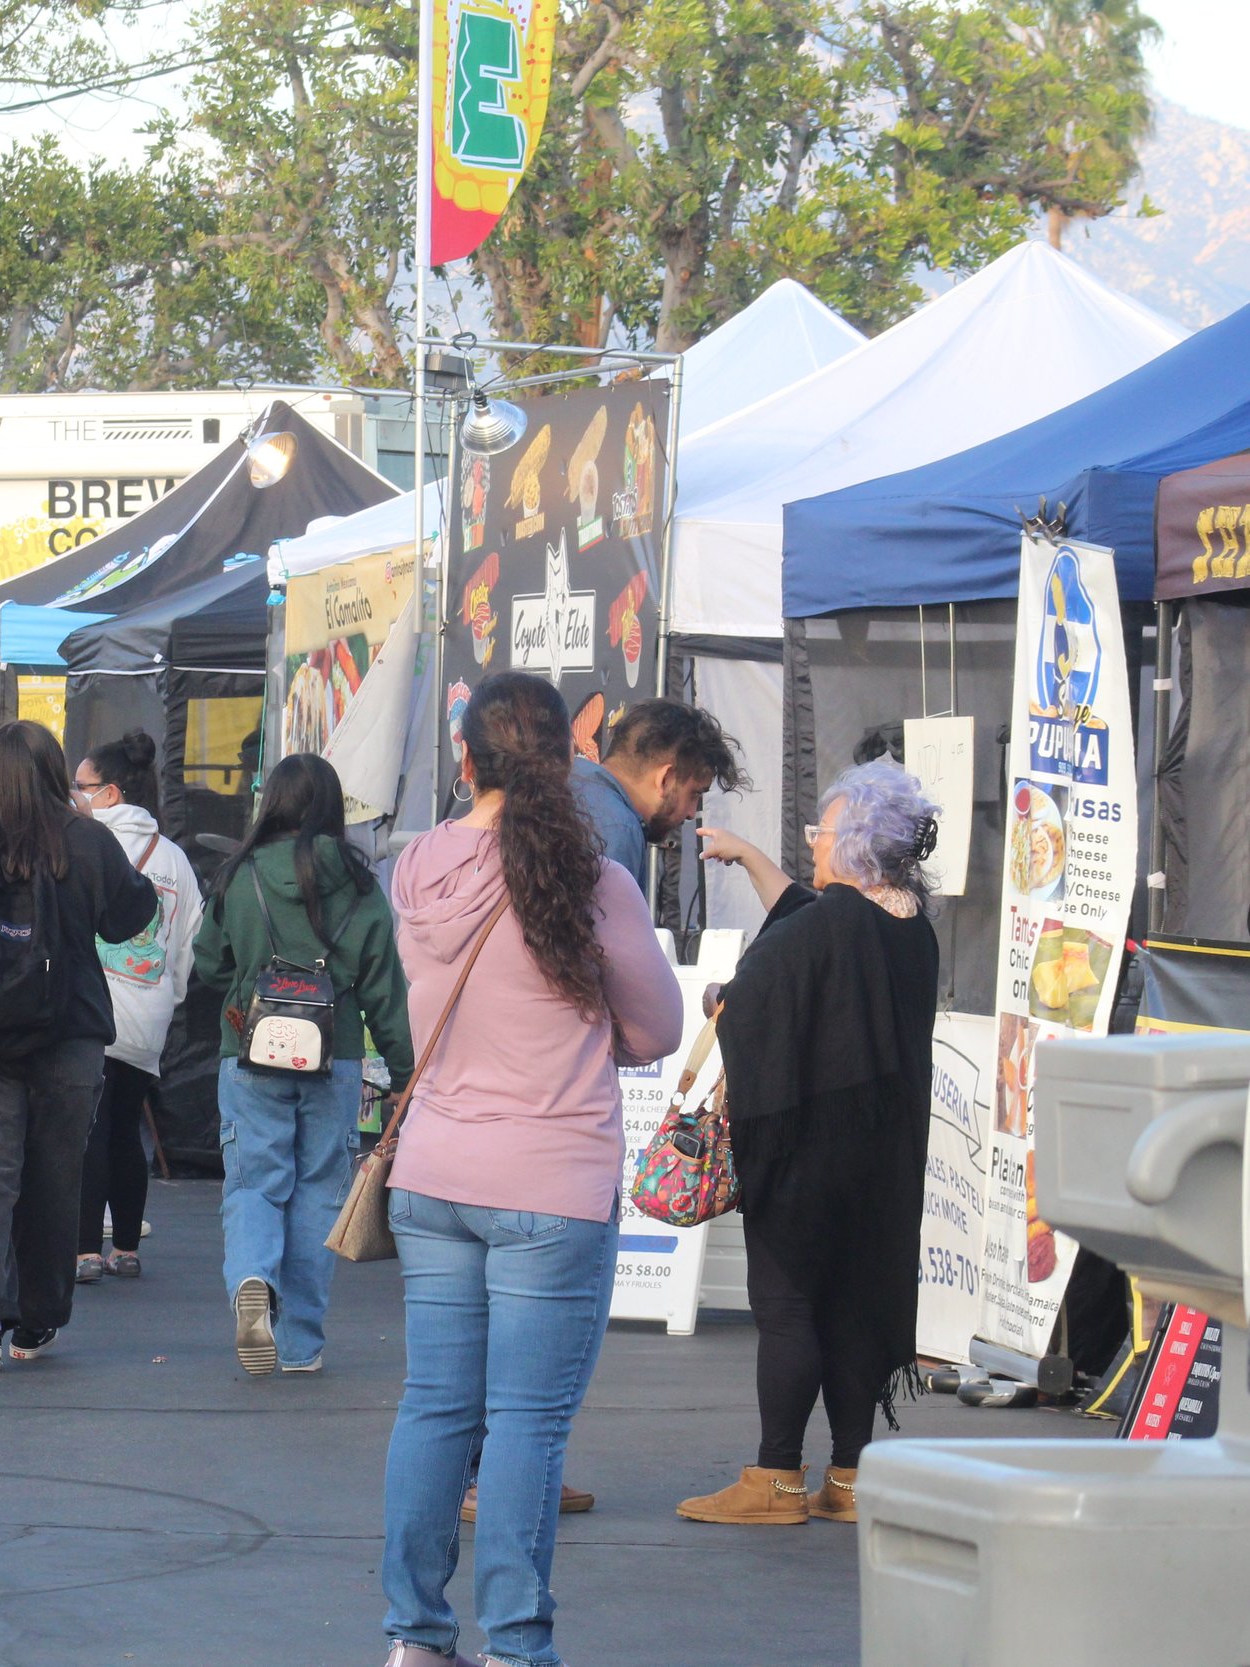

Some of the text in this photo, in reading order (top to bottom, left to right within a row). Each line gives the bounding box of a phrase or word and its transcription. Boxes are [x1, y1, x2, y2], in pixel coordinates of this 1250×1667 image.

[48, 420, 97, 441] THE
[325, 586, 372, 629] El Comalito
[514, 607, 590, 666] Coyote Elote
[152, 872, 177, 888] Today
[628, 1088, 664, 1102] $3.50
[624, 1120, 659, 1132] $4.00
[941, 1198, 969, 1236] MORE
[636, 1264, 671, 1278] $8.00
